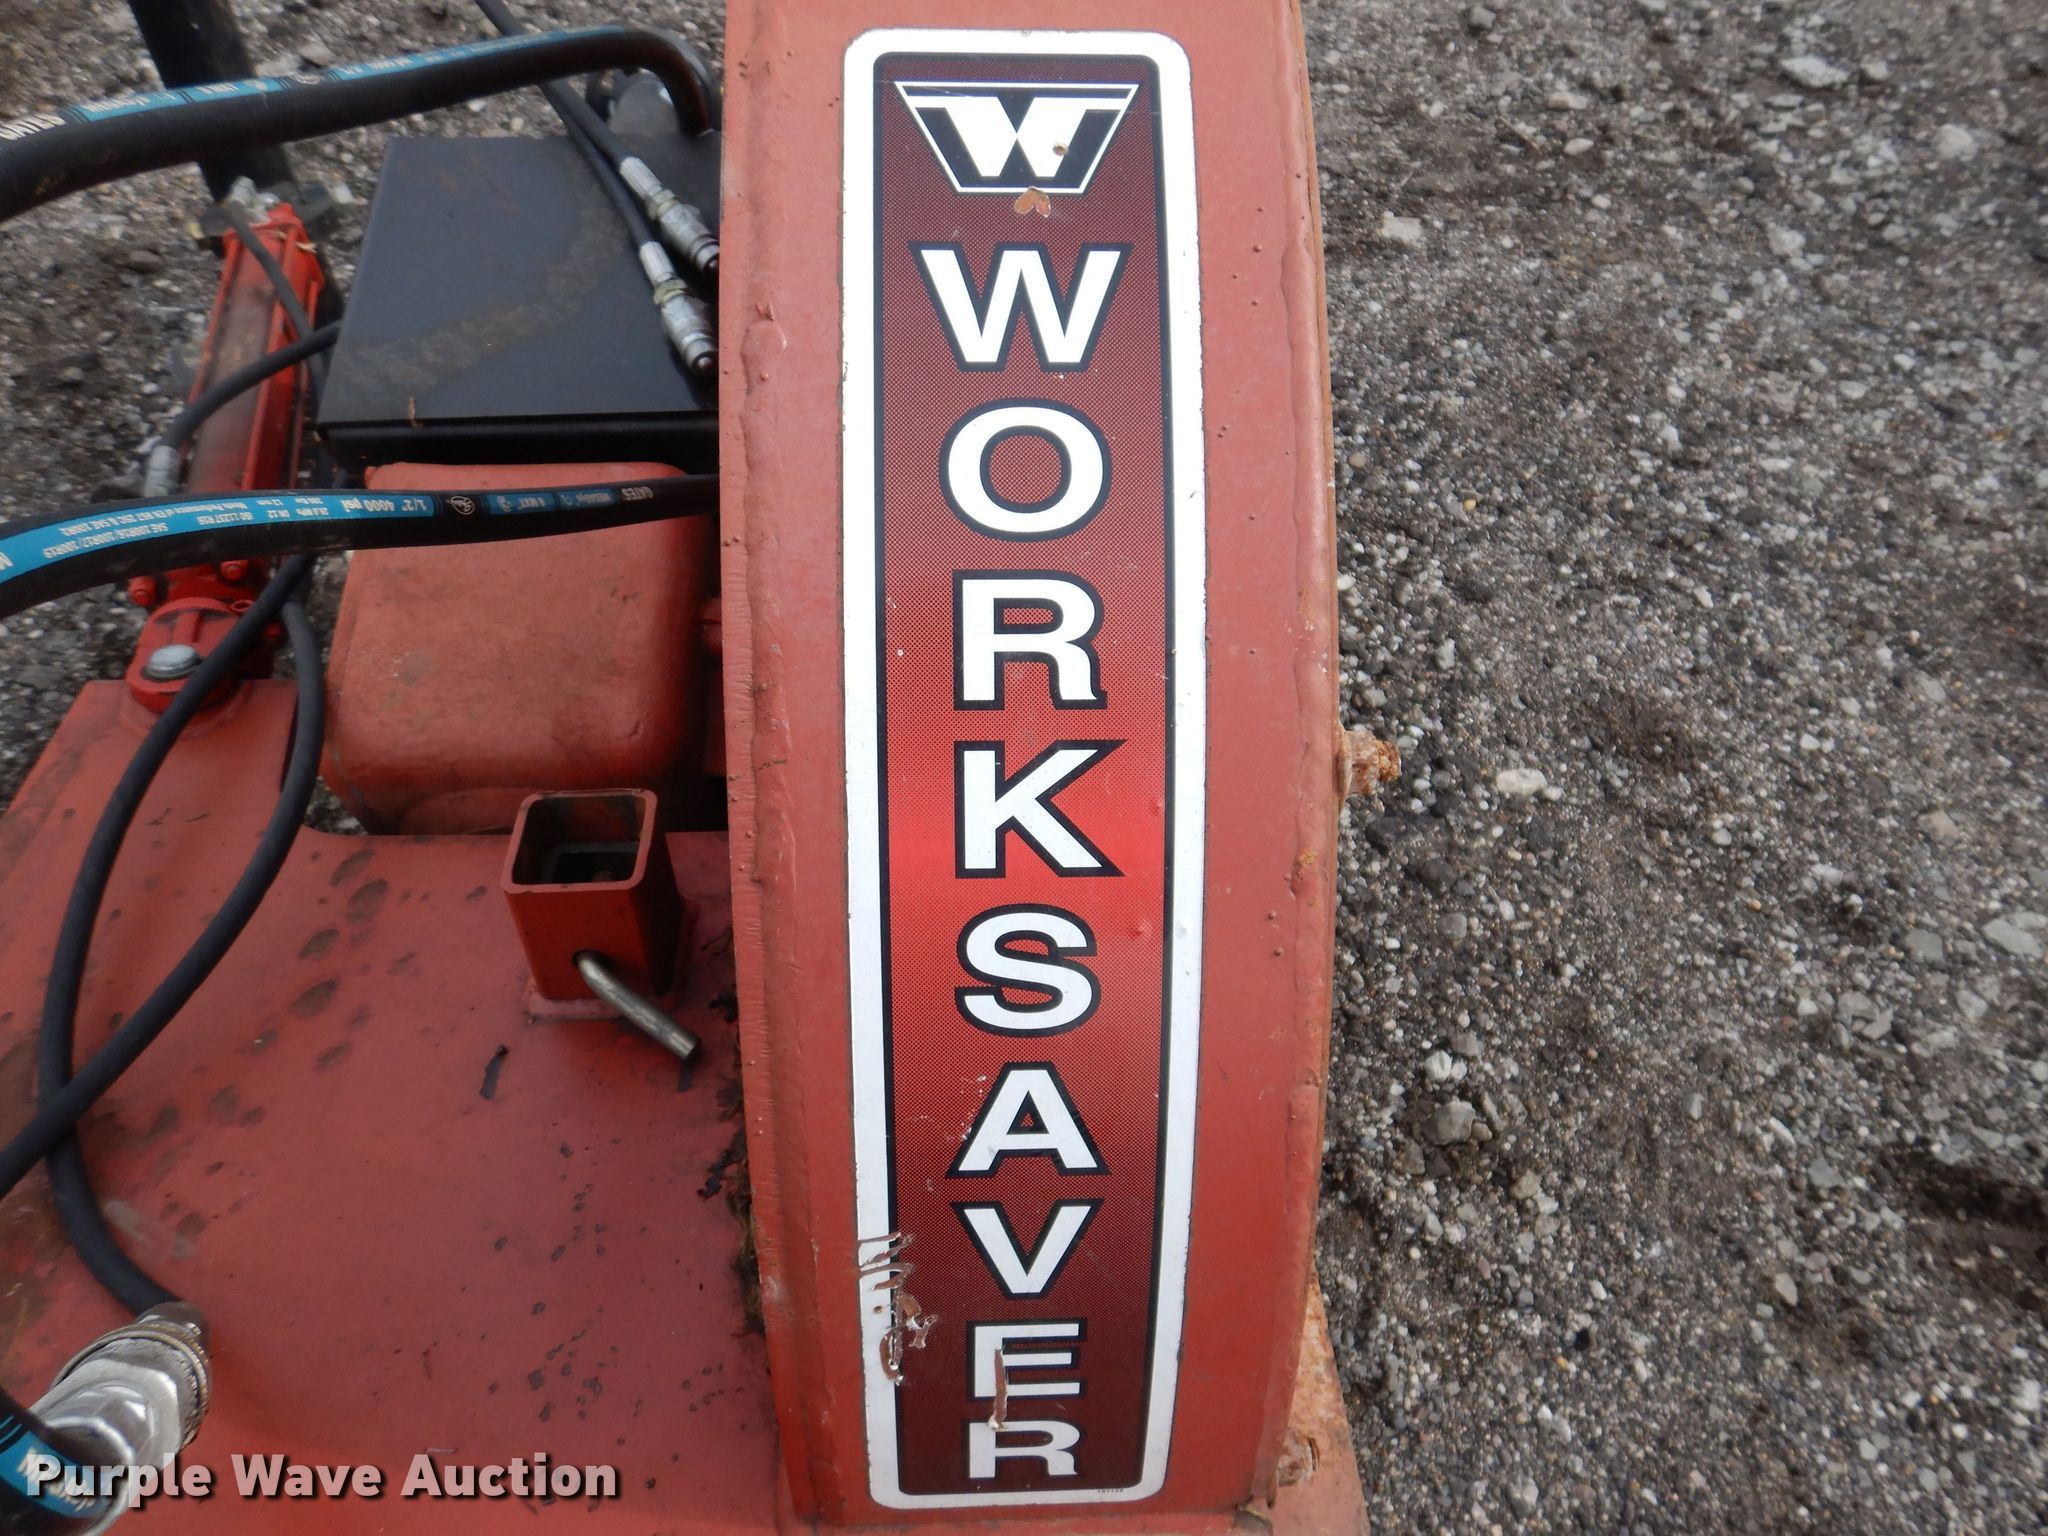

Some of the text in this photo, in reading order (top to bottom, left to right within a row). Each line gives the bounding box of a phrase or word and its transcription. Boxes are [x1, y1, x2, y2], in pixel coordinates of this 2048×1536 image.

[620, 485, 654, 501] GATES
[340, 497, 363, 513] psi
[363, 499, 395, 512] 4000
[918, 249, 1123, 1480] WORKSAVER
